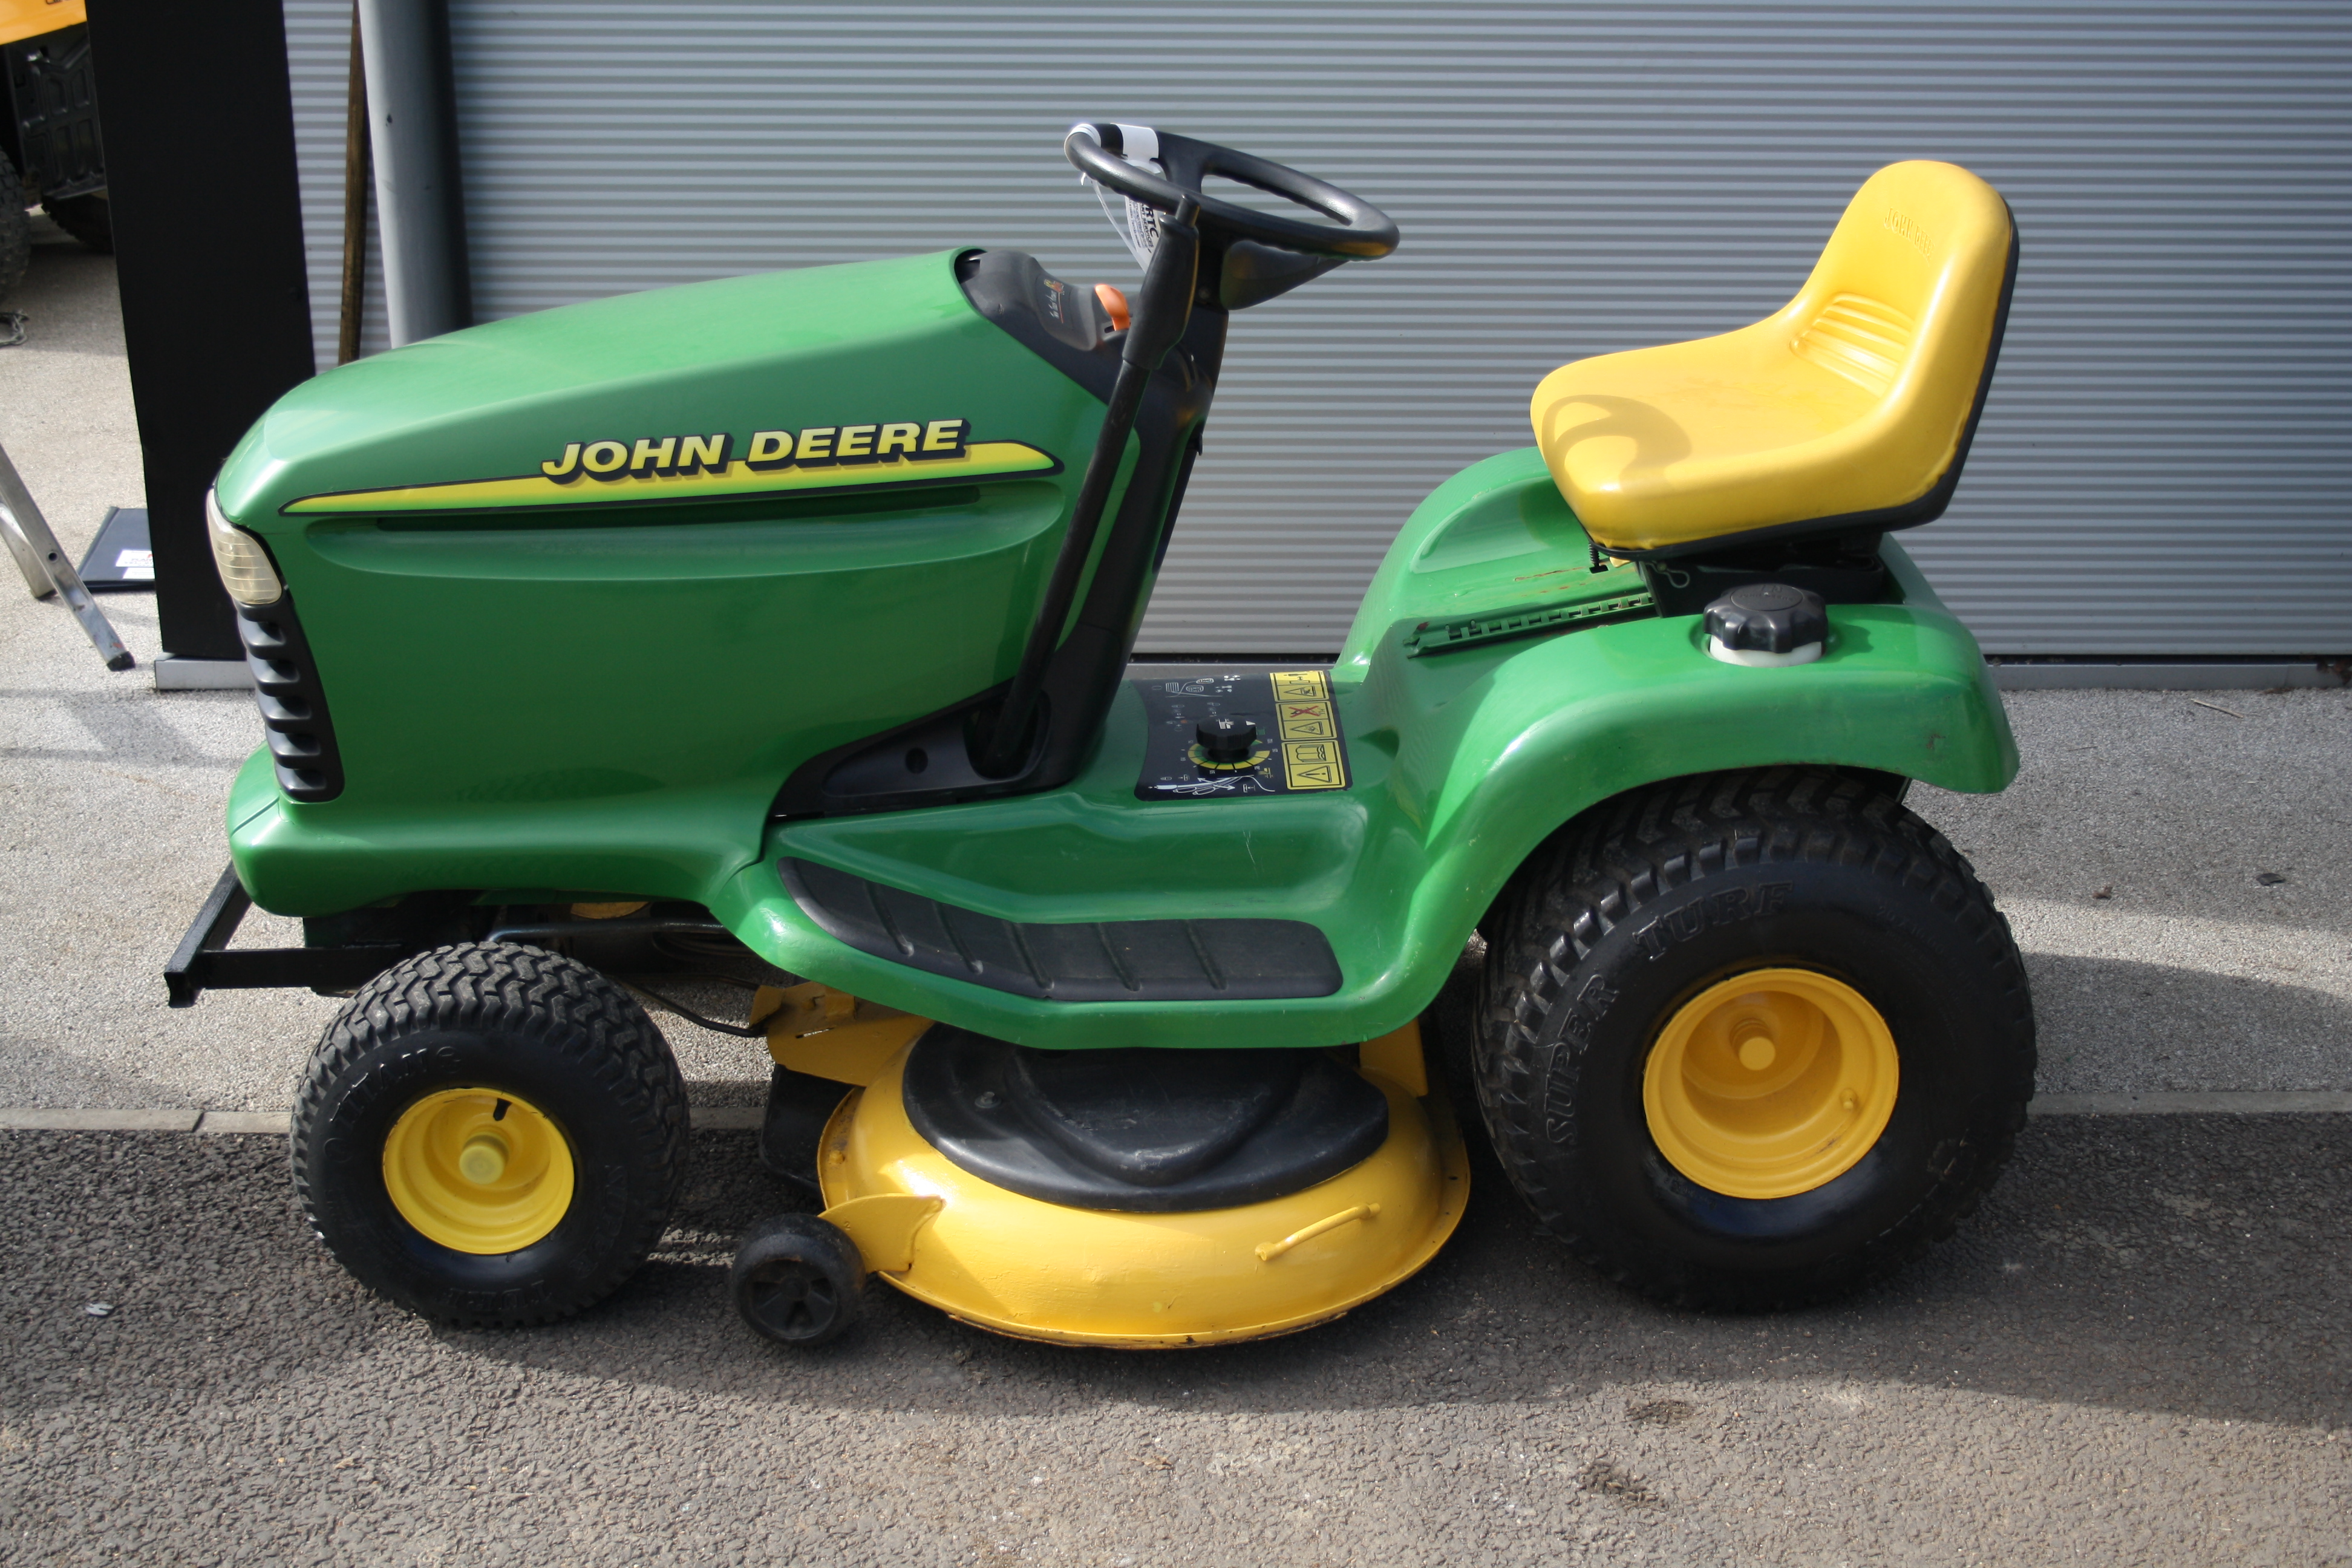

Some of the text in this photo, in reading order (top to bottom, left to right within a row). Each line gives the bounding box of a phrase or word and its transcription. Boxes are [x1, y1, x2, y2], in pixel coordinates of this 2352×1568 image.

[541, 419, 969, 482] JOHN DEERE
[1544, 881, 1794, 1146] SUPER TURF
